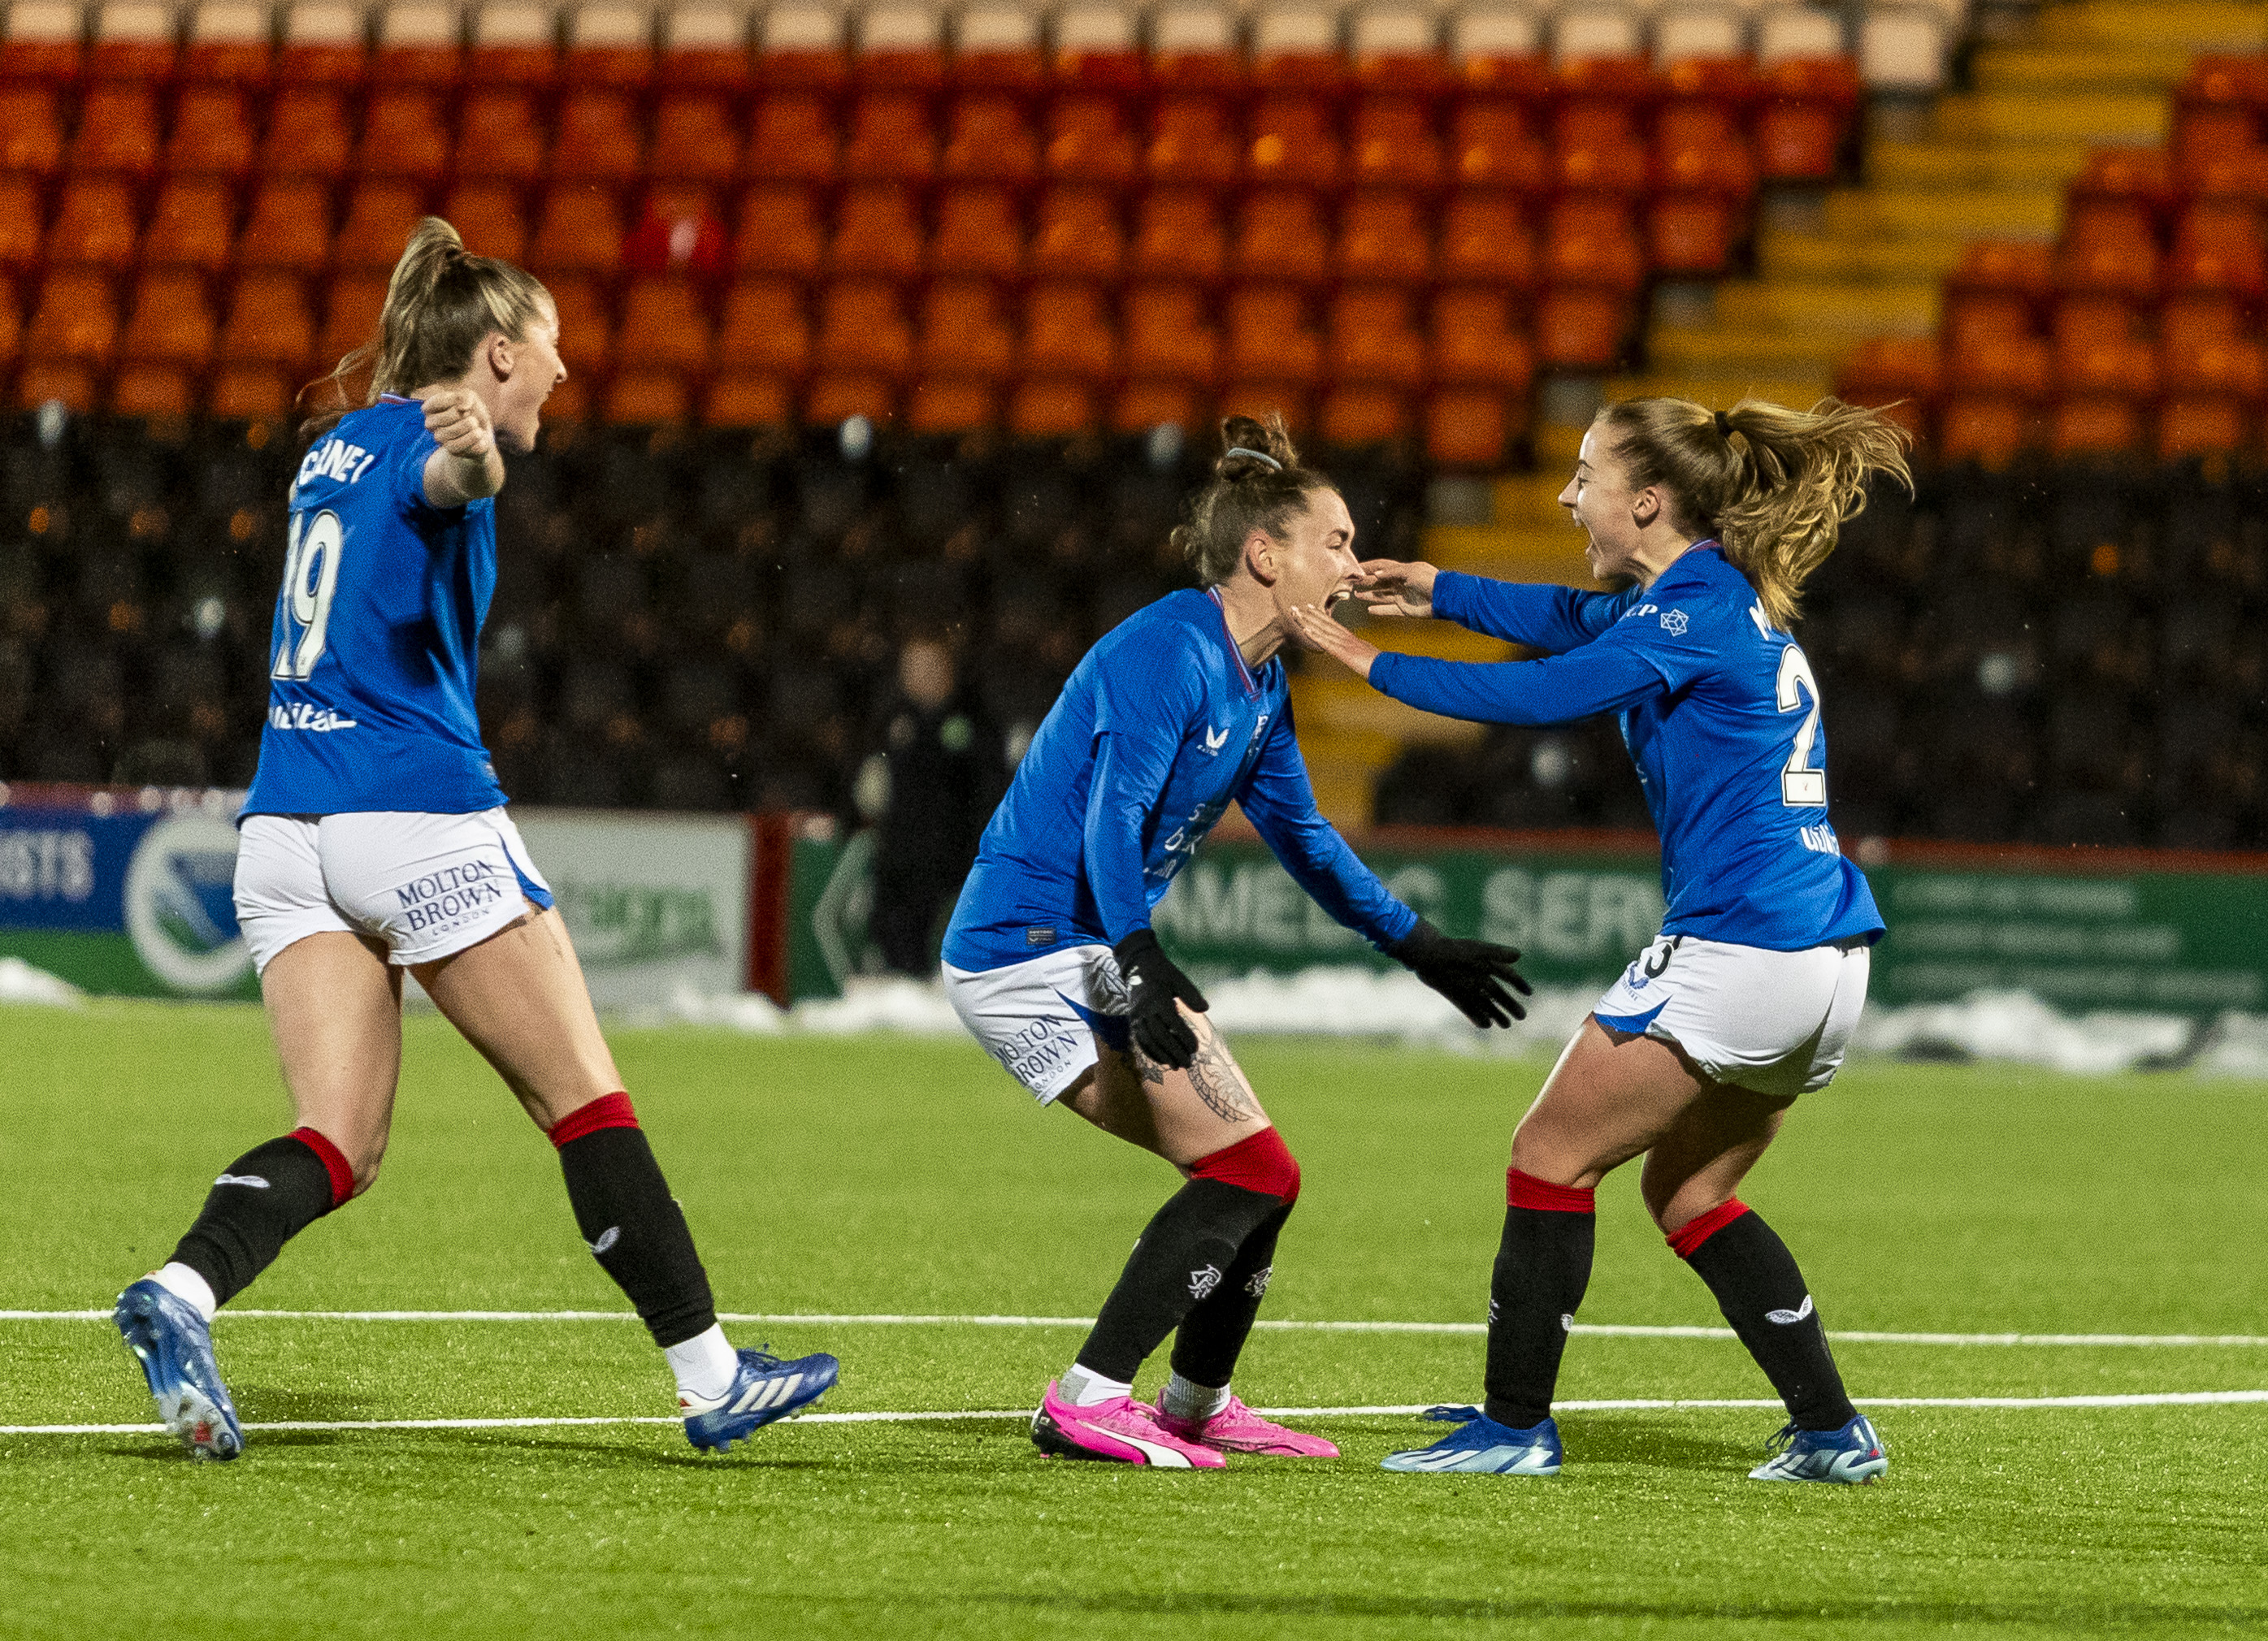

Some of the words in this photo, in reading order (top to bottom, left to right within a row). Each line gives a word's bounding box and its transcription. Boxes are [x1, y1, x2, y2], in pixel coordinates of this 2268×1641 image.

[271, 509, 342, 681] 19
[396, 859, 494, 909] MOLTON
[406, 880, 502, 932] BROWN
[995, 1015, 1062, 1065] MOTON
[1014, 1030, 1078, 1086] ROWN
